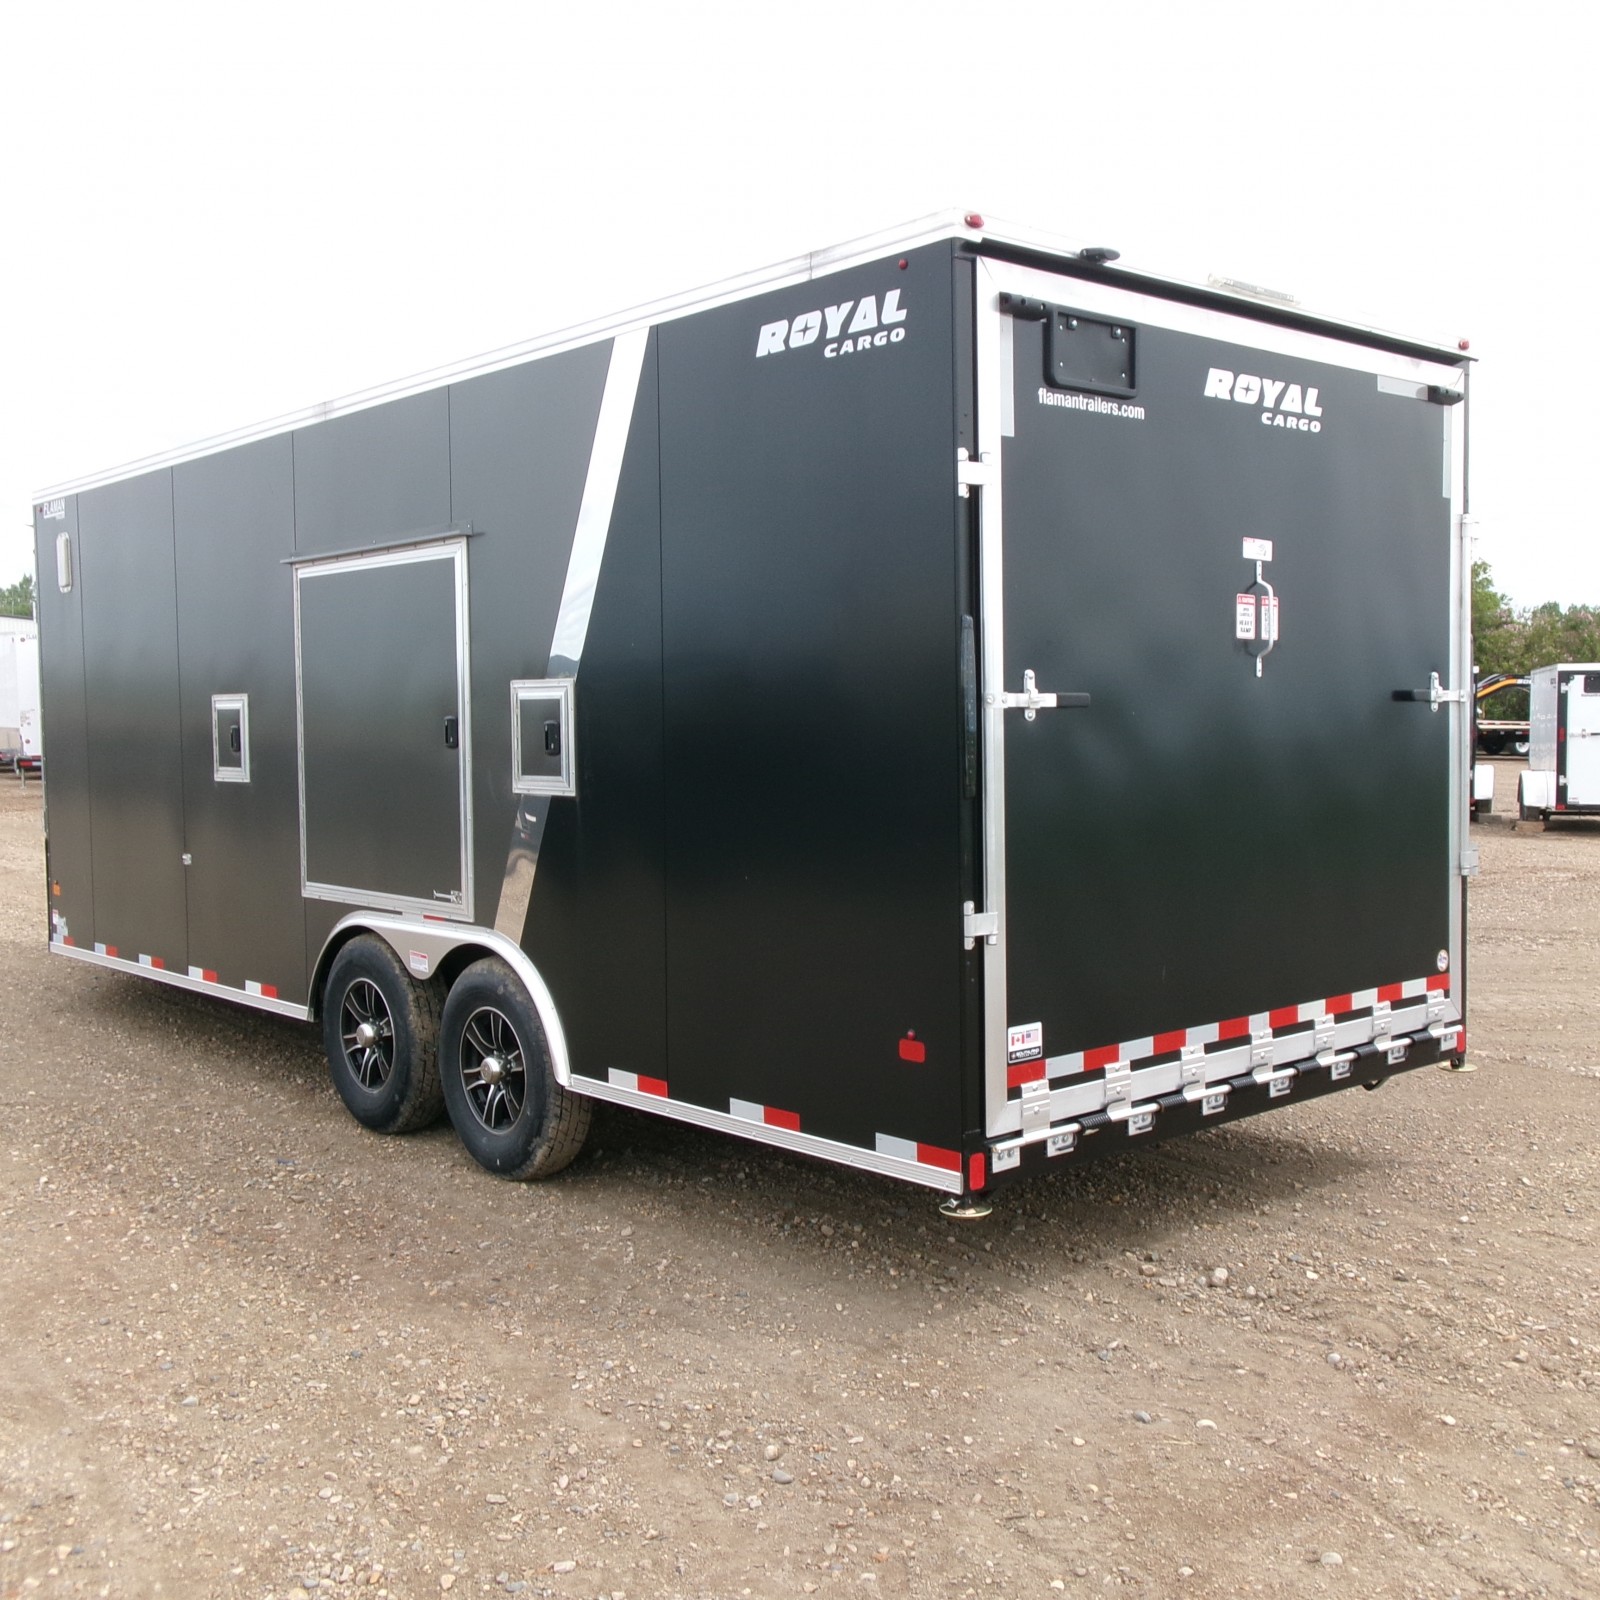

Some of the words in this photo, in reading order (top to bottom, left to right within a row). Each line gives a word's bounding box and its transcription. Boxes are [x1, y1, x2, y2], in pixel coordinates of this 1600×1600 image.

[756, 288, 908, 358] ROYAL
[824, 327, 906, 358] CARGO
[1038, 387, 1145, 420] flamantrailers.com
[1203, 367, 1322, 417] ROYAL
[1261, 412, 1321, 433] CARGO
